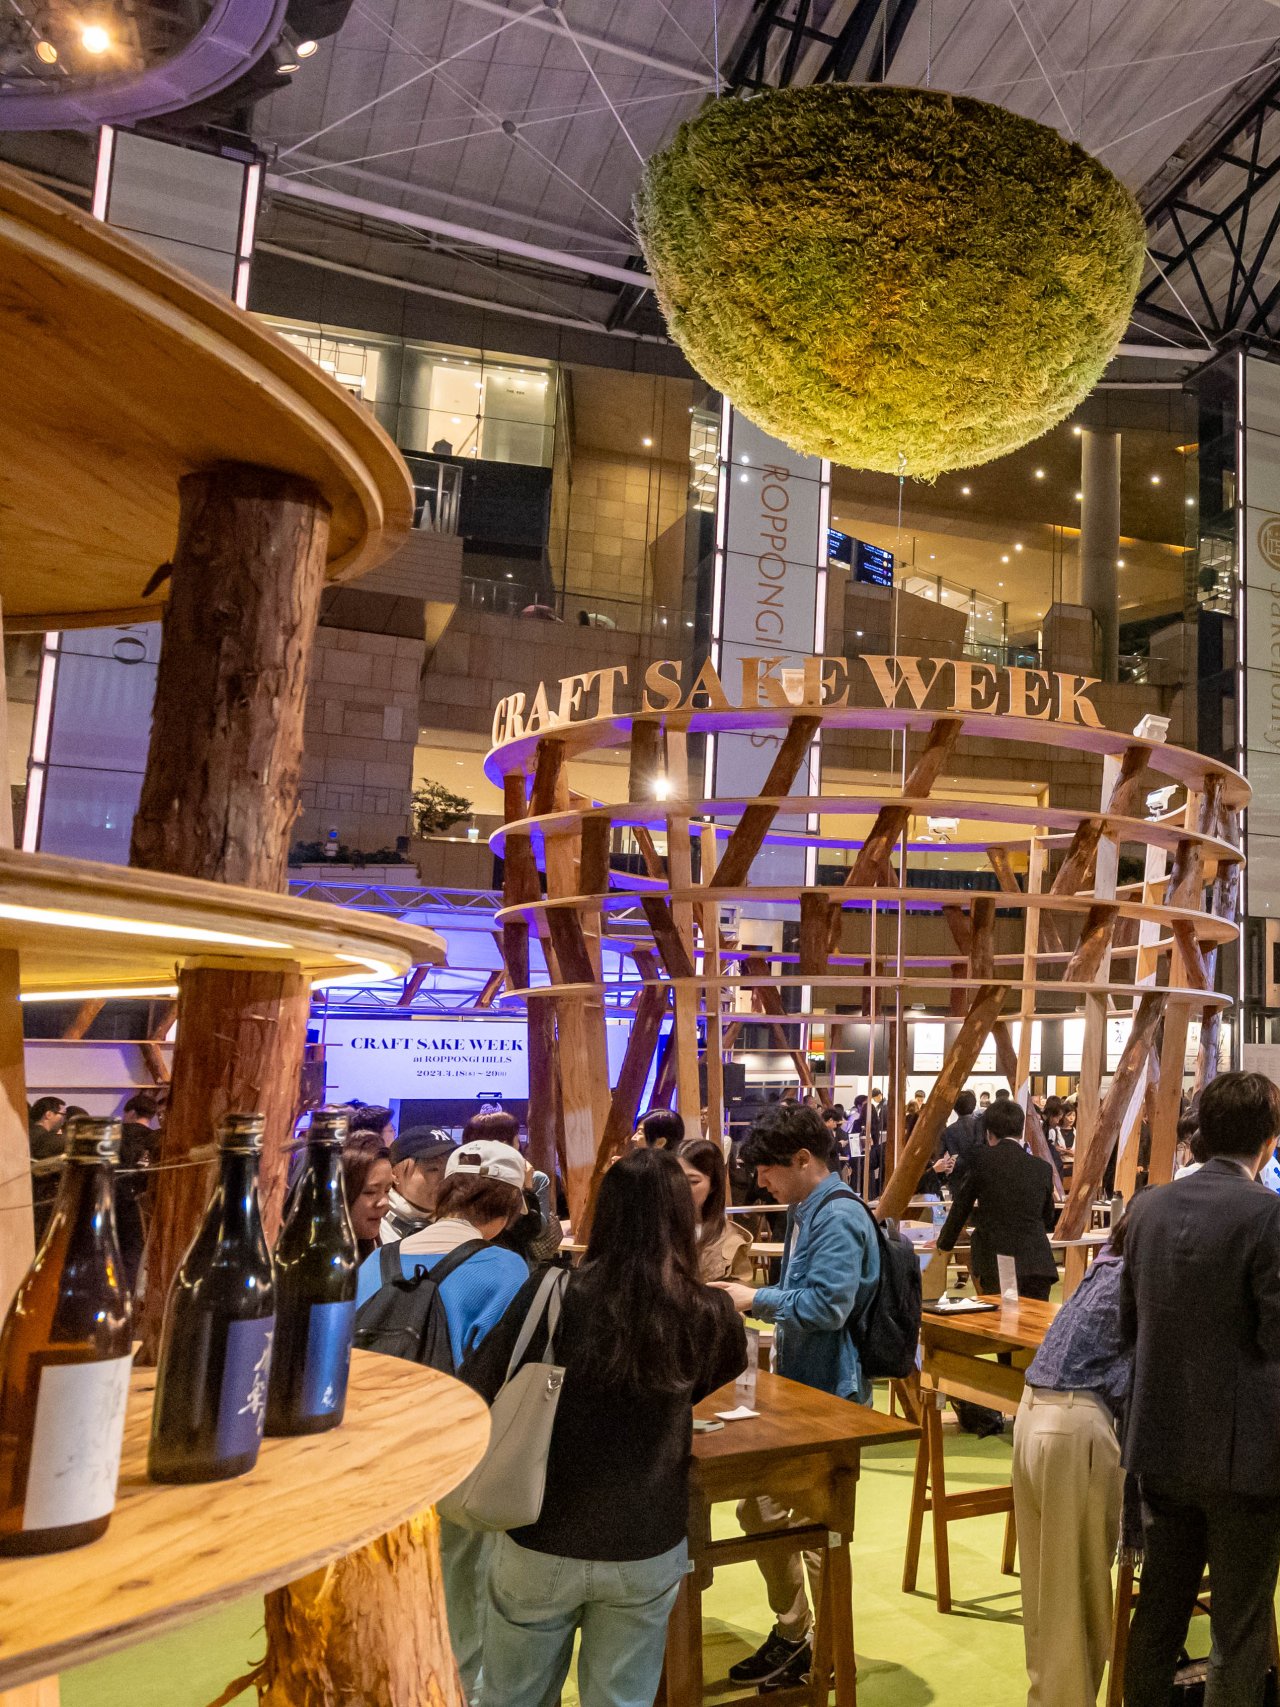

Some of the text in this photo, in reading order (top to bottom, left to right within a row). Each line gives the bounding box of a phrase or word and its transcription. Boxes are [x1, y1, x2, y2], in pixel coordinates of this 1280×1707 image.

[755, 463, 791, 644] ROPPONGI
[491, 665, 629, 748] CRAFT
[641, 655, 850, 712] SAKE
[858, 654, 1106, 728] WEEK
[351, 1037, 523, 1051] CRAFT SAKE WEEK
[424, 1055, 480, 1063] ROPPONGI
